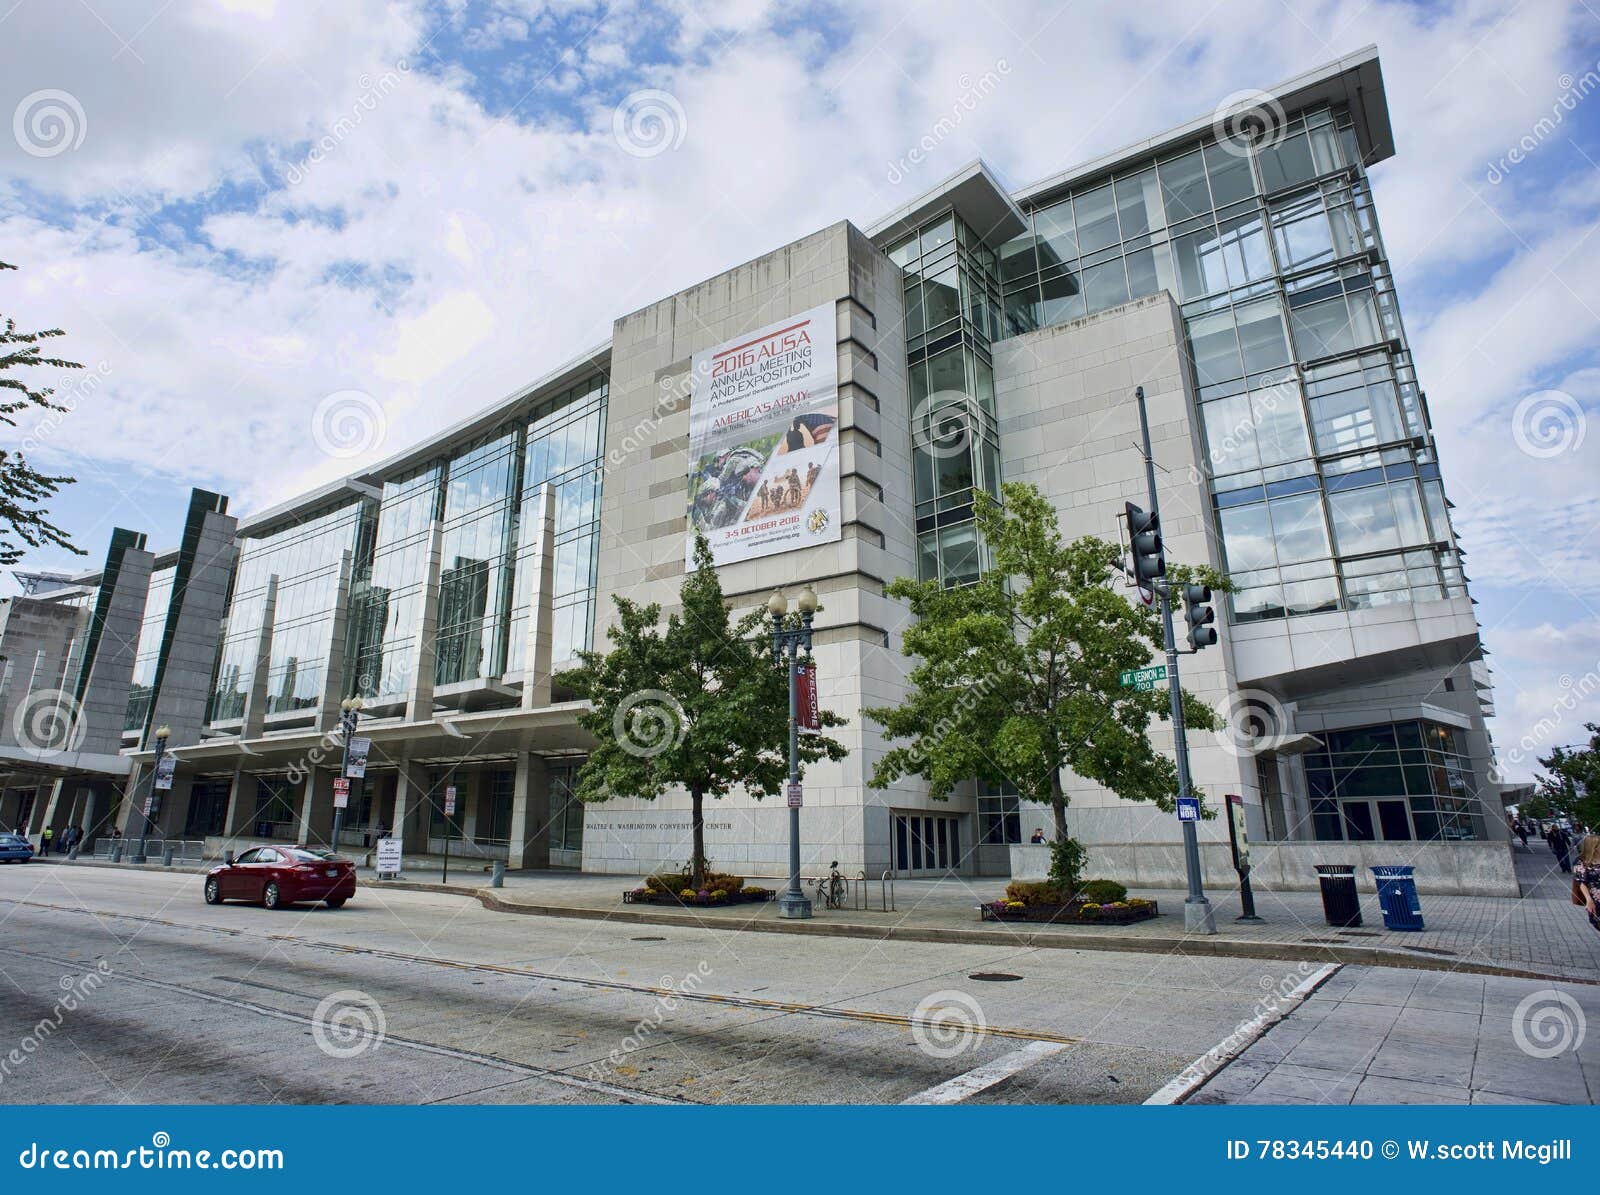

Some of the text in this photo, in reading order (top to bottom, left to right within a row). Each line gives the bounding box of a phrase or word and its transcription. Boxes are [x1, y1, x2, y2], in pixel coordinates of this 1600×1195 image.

[711, 345, 811, 390] ANNUAL MEETING
[712, 330, 811, 378] 2016 AUSA
[710, 358, 812, 401] AND EXPOSITION
[752, 379, 790, 395] Development
[712, 402, 771, 429] AMERICA'S
[725, 530, 739, 539] 3-5
[741, 520, 777, 535] OCTOBER
[779, 515, 800, 526] 2016
[1133, 668, 1158, 682] VERNON
[1136, 682, 1151, 690] 700
[809, 668, 818, 727] WELCOME
